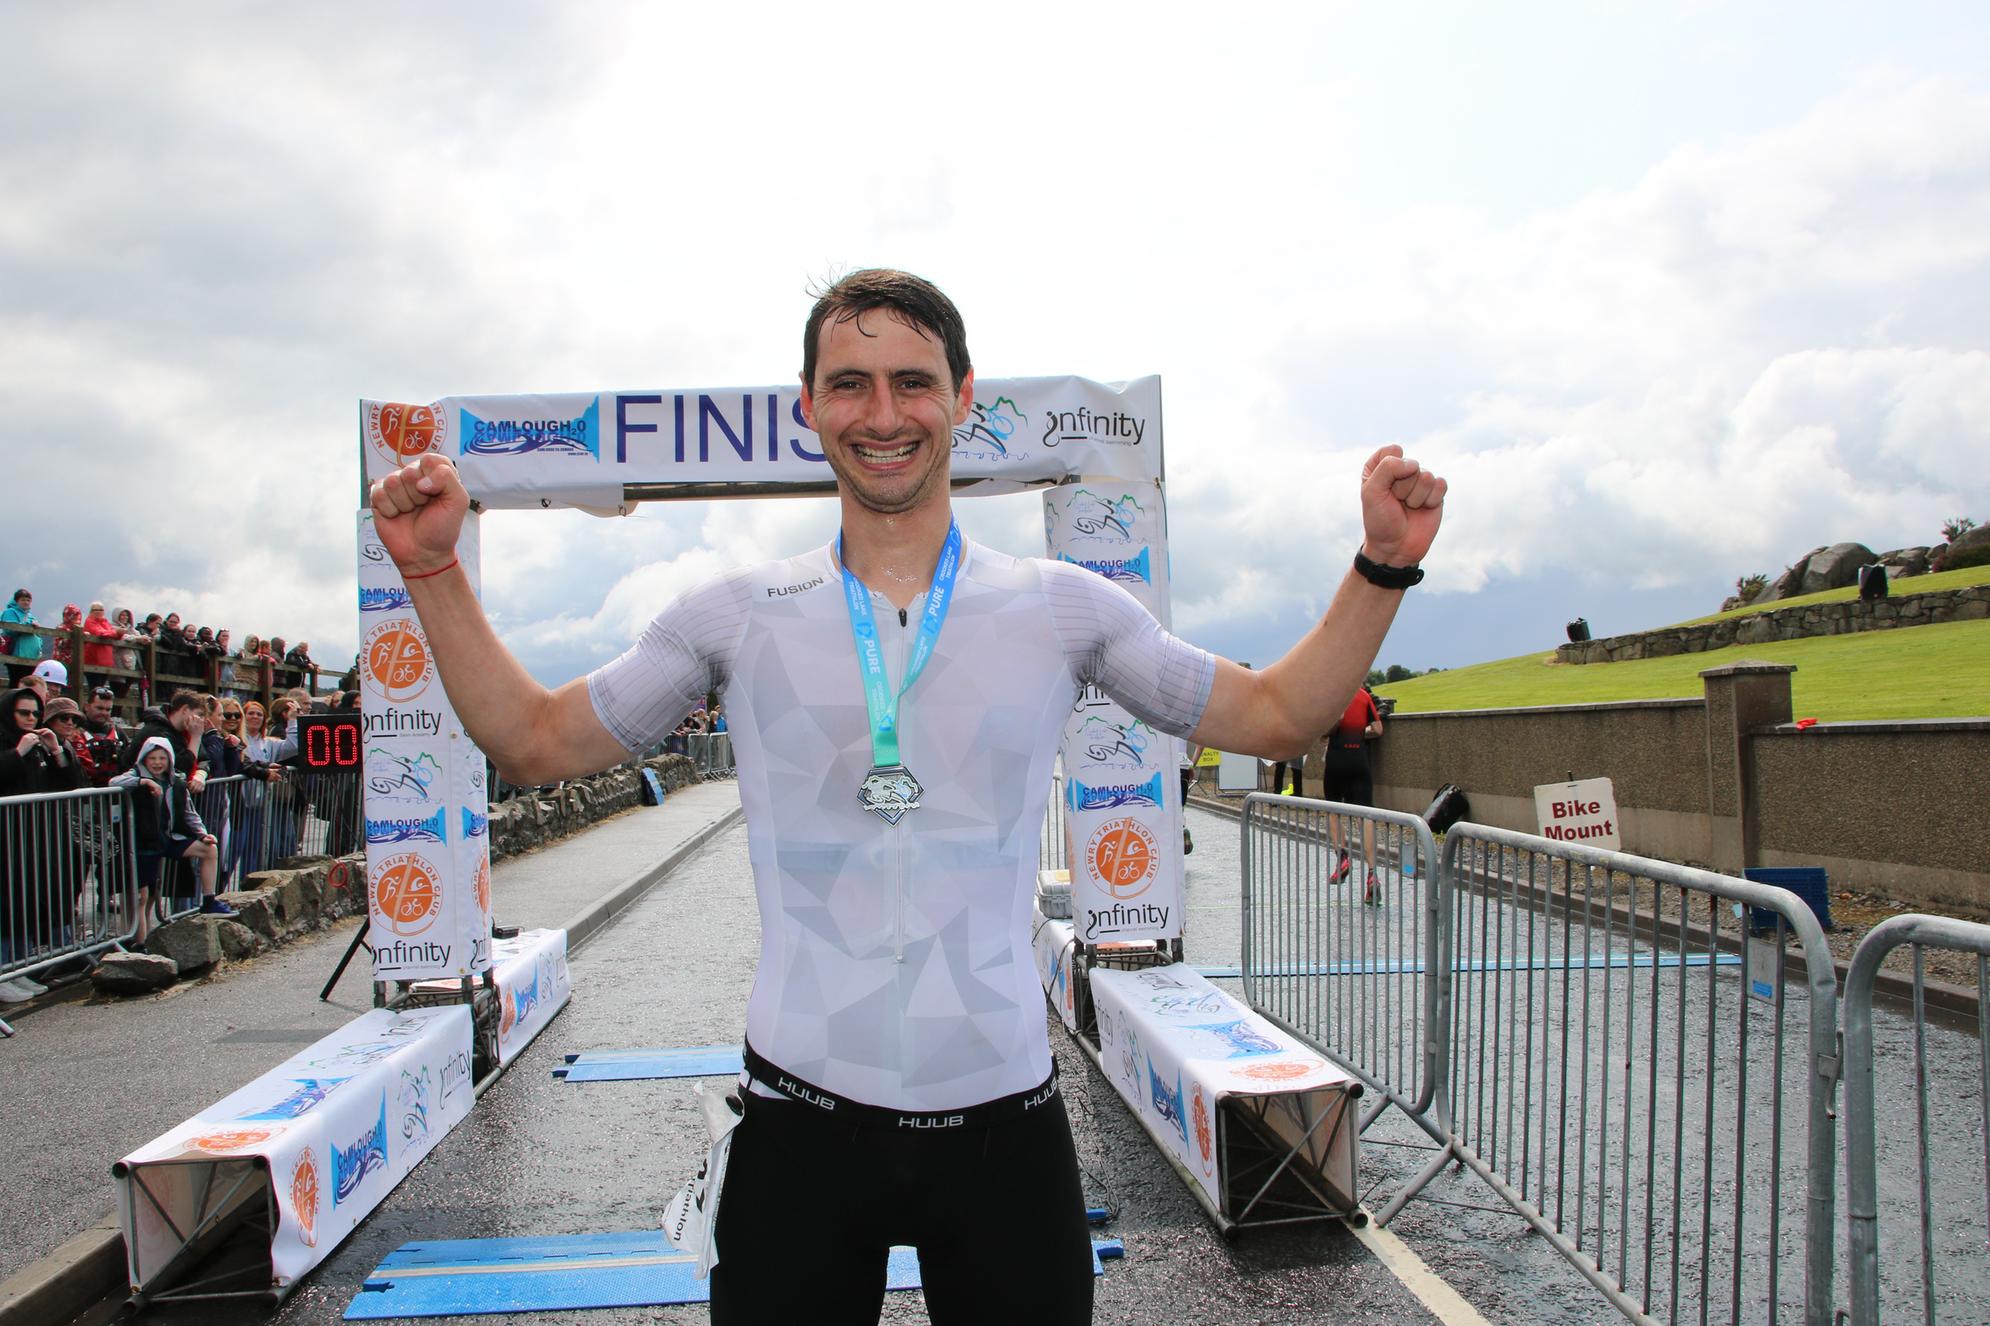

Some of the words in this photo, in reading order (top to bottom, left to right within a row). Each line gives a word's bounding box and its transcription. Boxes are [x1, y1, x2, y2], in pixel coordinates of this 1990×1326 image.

[371, 404, 384, 448] NEWRY
[616, 393, 828, 463] FINIS
[1042, 407, 1146, 447] infinity
[767, 577, 825, 597] FUSION
[928, 585, 945, 617] PURE
[362, 639, 374, 682] NEWRY
[370, 622, 429, 648] TRIATHLON
[422, 651, 434, 682] CLUB
[864, 639, 881, 675] PURE
[307, 724, 358, 766] 00
[1552, 800, 1601, 819] Bike
[1087, 838, 1100, 880] NEWRY
[1096, 820, 1154, 845] TRIATHLON
[1146, 848, 1158, 880] CLUB
[1544, 820, 1613, 841] Mount
[369, 873, 381, 916] NEWRY
[377, 855, 438, 882] TRIATHLON
[429, 885, 441, 917] CLUB
[1086, 903, 1169, 940] infinity
[778, 1077, 836, 1111] HUUB
[898, 1115, 964, 1129] HUUB
[1024, 1076, 1058, 1111] HUUB
